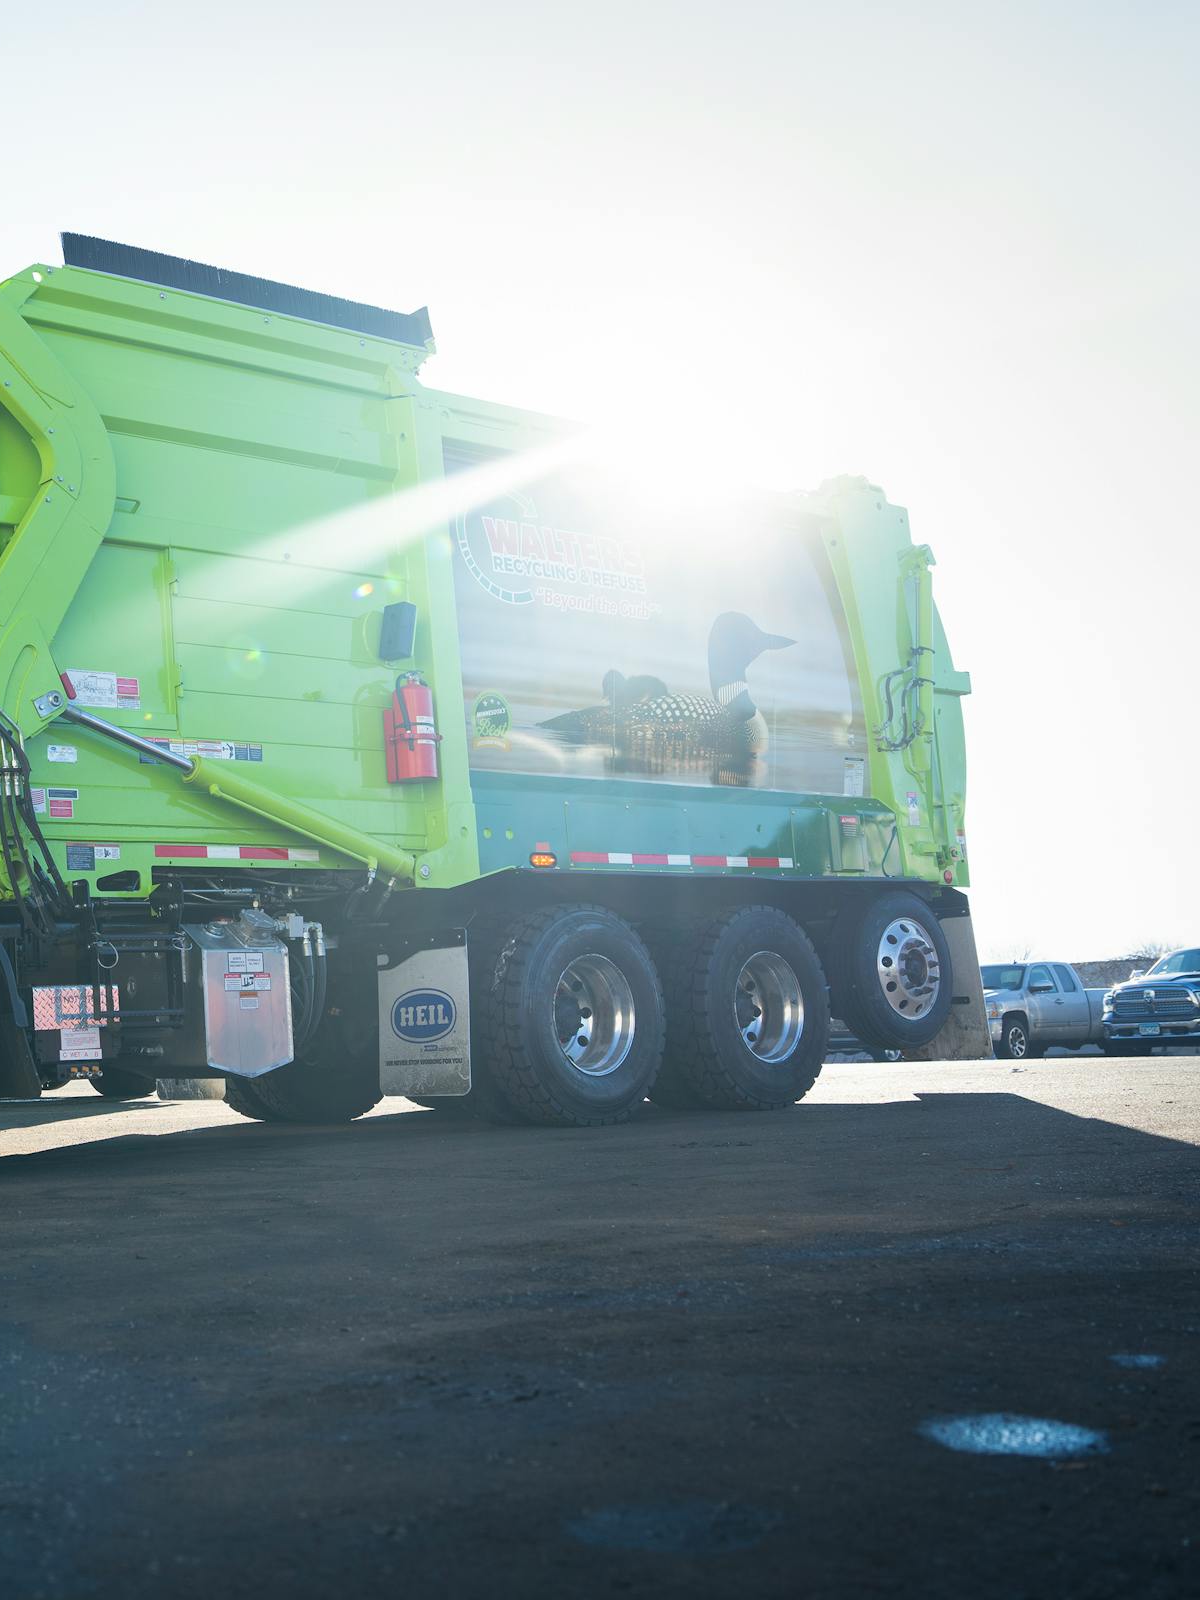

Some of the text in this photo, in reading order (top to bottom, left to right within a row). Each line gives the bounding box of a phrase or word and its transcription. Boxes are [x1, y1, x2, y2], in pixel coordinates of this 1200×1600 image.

[482, 517, 643, 572] WALTERS
[493, 555, 646, 592] RECYCLING & REFUSE
[597, 598, 618, 615] the
[477, 718, 508, 737] Best
[399, 1004, 449, 1027] HEIL
